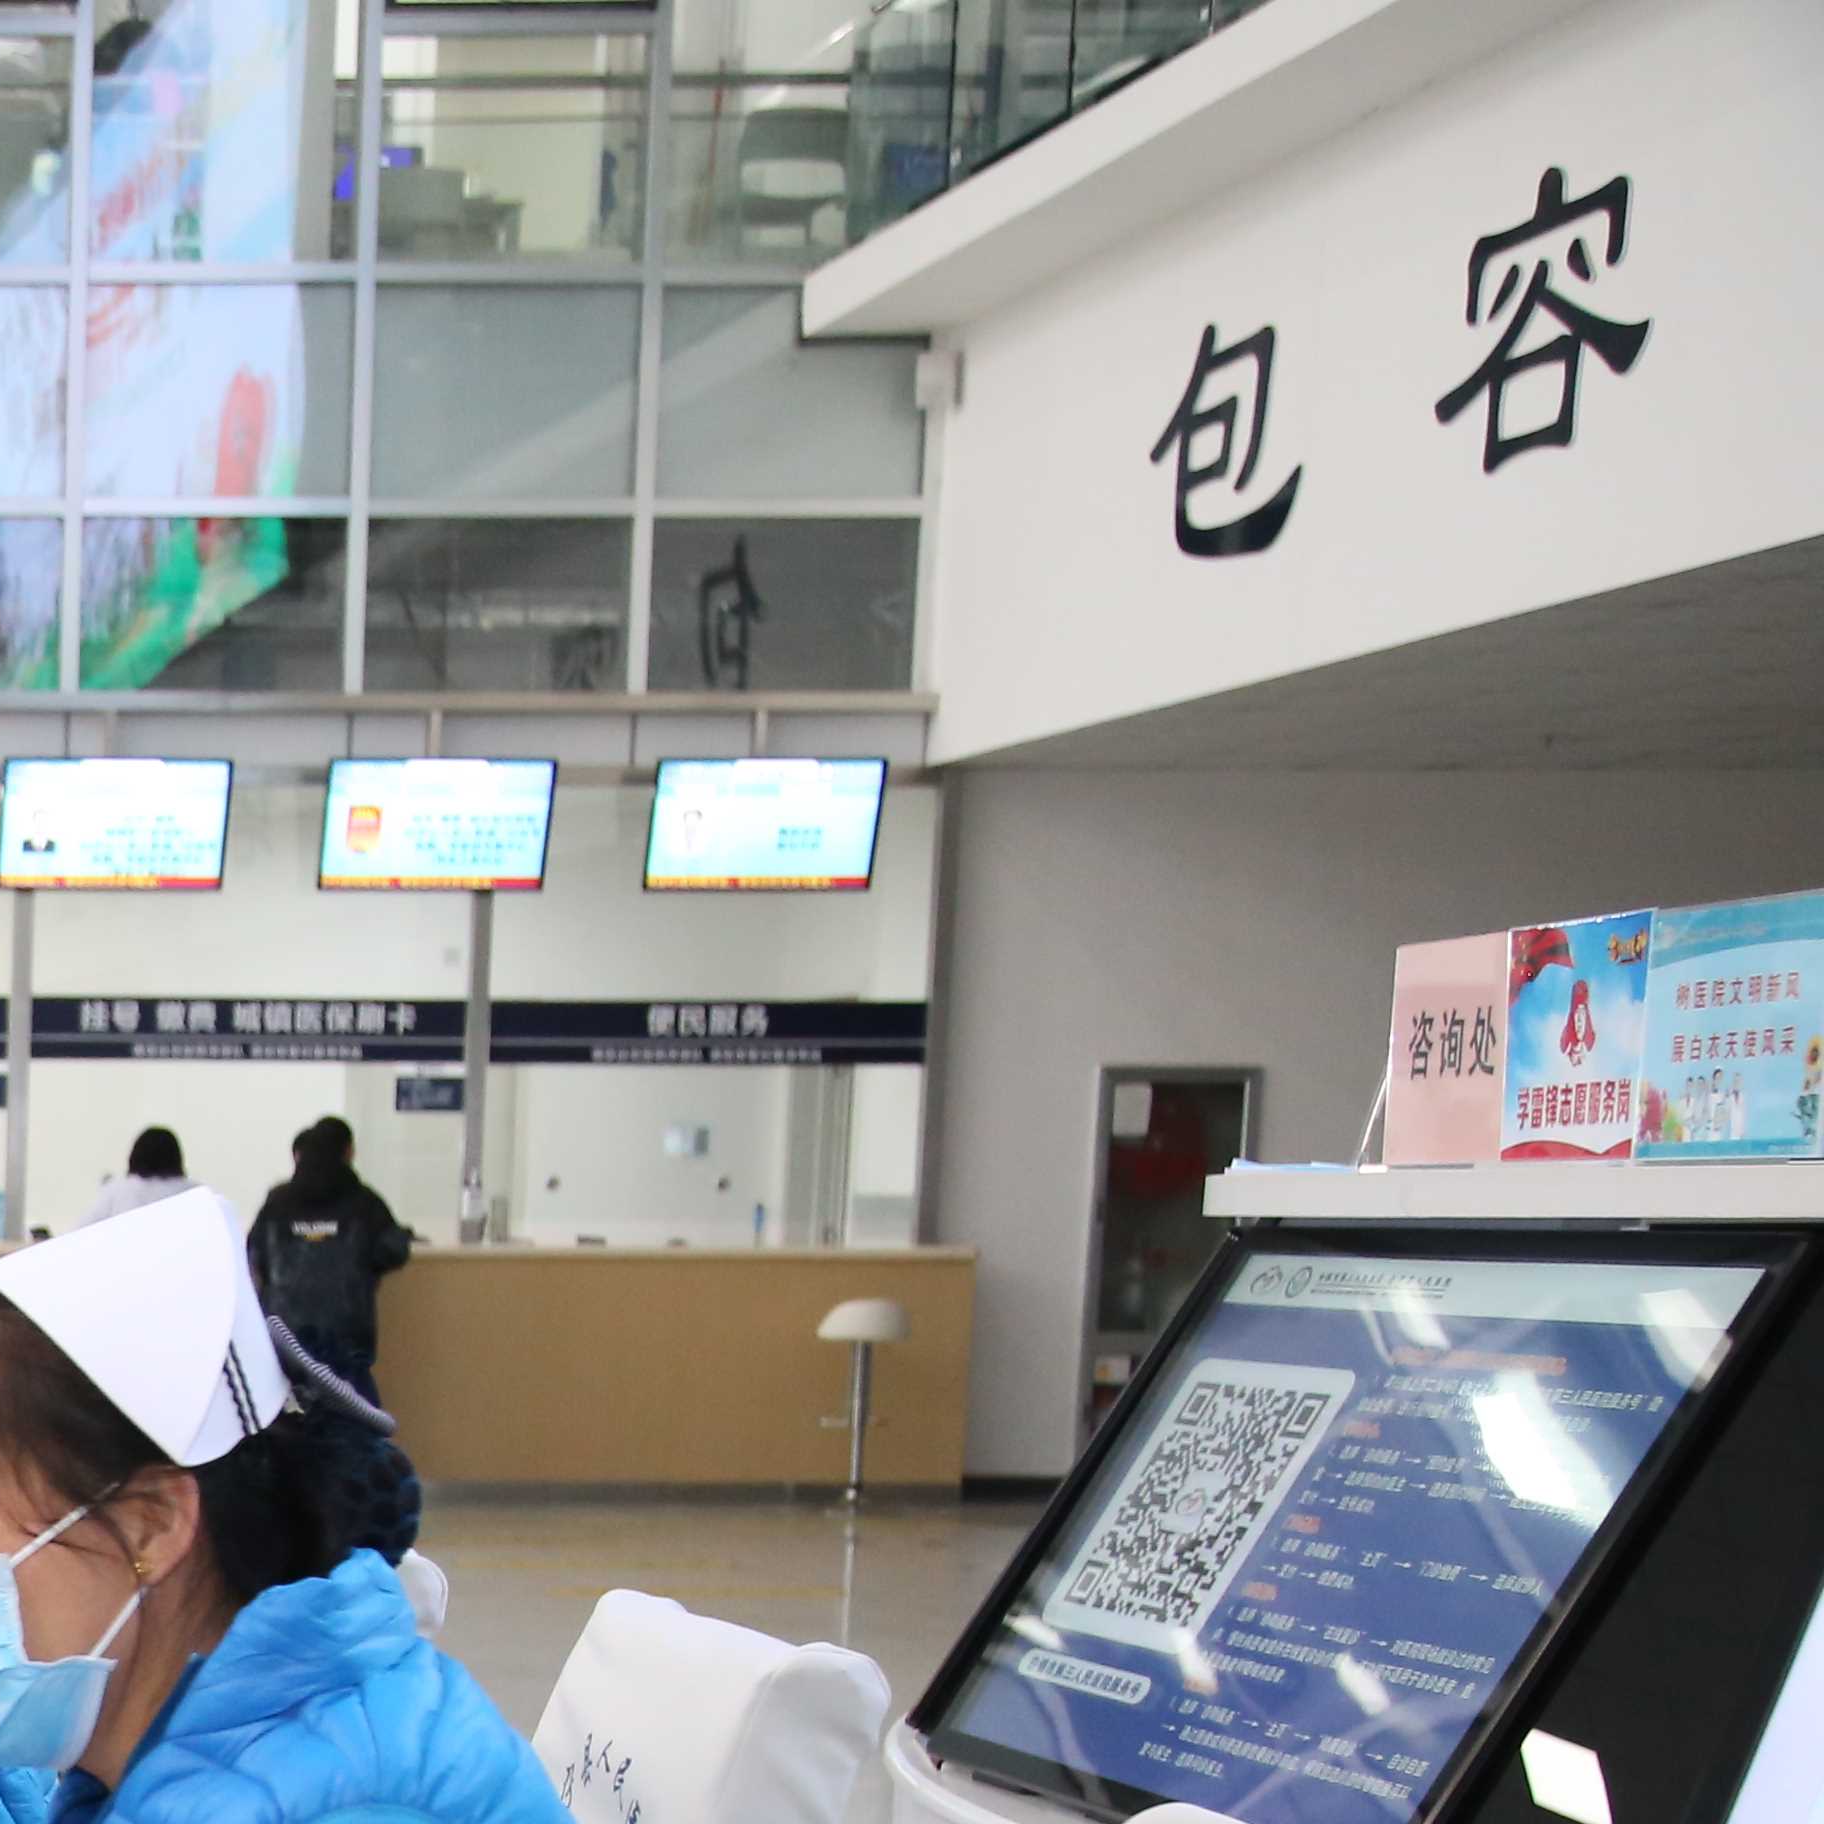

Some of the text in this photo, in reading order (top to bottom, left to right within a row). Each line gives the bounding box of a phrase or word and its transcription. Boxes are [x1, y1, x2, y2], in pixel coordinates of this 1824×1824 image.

[1150, 167, 1654, 559] 包容
[646, 1003, 770, 1037] 便民服务
[1408, 1004, 1497, 1081] 咨询处
[1516, 1077, 1632, 1132] 学雷锋志愿服务岗
